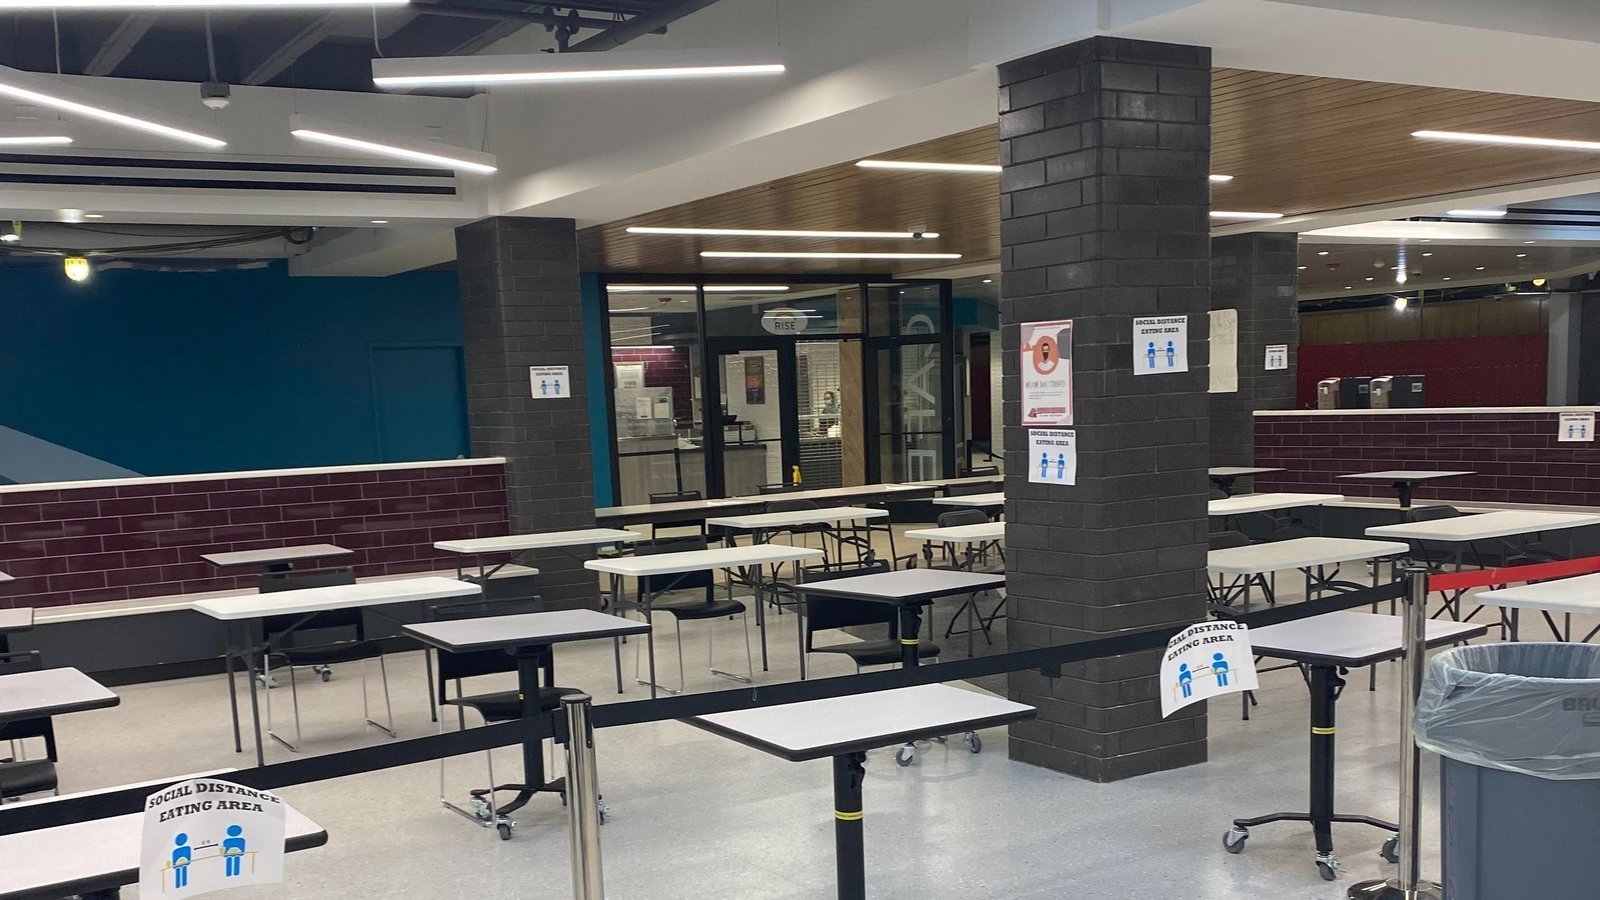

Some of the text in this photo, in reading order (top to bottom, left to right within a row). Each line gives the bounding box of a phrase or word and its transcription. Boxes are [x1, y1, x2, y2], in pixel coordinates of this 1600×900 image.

[774, 321, 796, 331] RISE
[1141, 327, 1163, 335] EATING
[1157, 317, 1186, 325] DISTANCE
[1168, 623, 1245, 649] CIAL DISTANCE
[1167, 634, 1235, 662] EATING AREA
[149, 782, 281, 809] SOCIAL DISTANCE
[159, 800, 264, 823] EATING AREA
